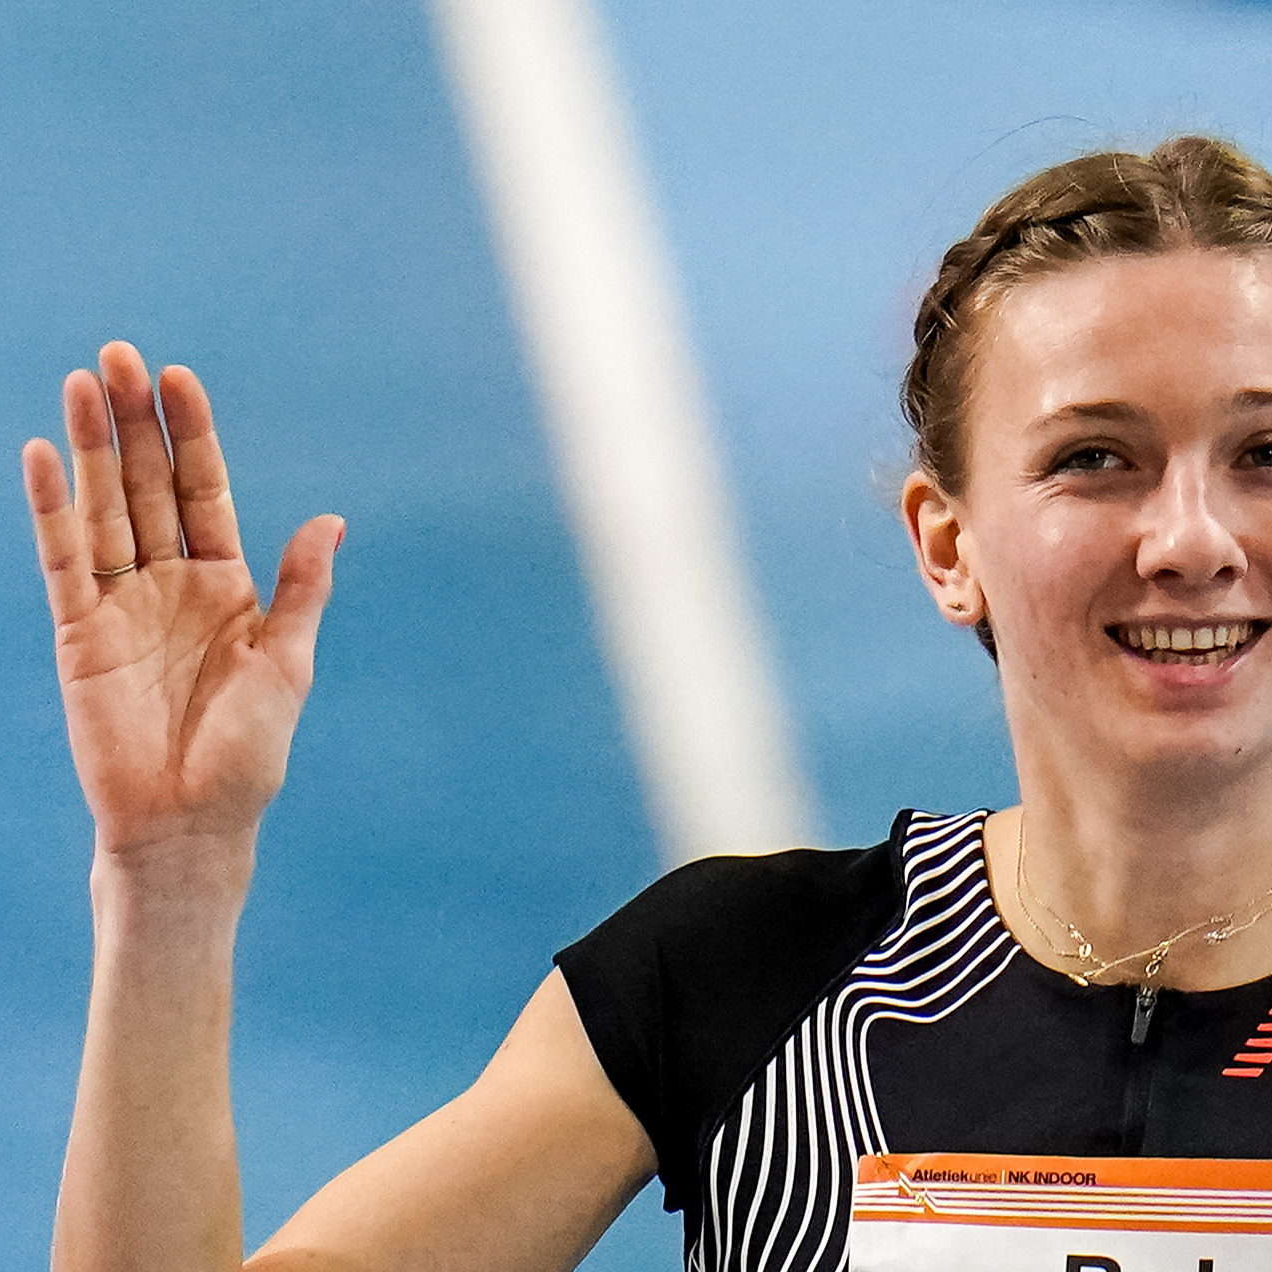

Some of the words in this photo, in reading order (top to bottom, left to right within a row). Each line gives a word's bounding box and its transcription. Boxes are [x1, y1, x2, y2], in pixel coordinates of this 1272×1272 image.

[911, 1168, 998, 1184] Atletiekunie
[1008, 1170, 1031, 1184] NK
[1033, 1171, 1097, 1186] INDOOR
